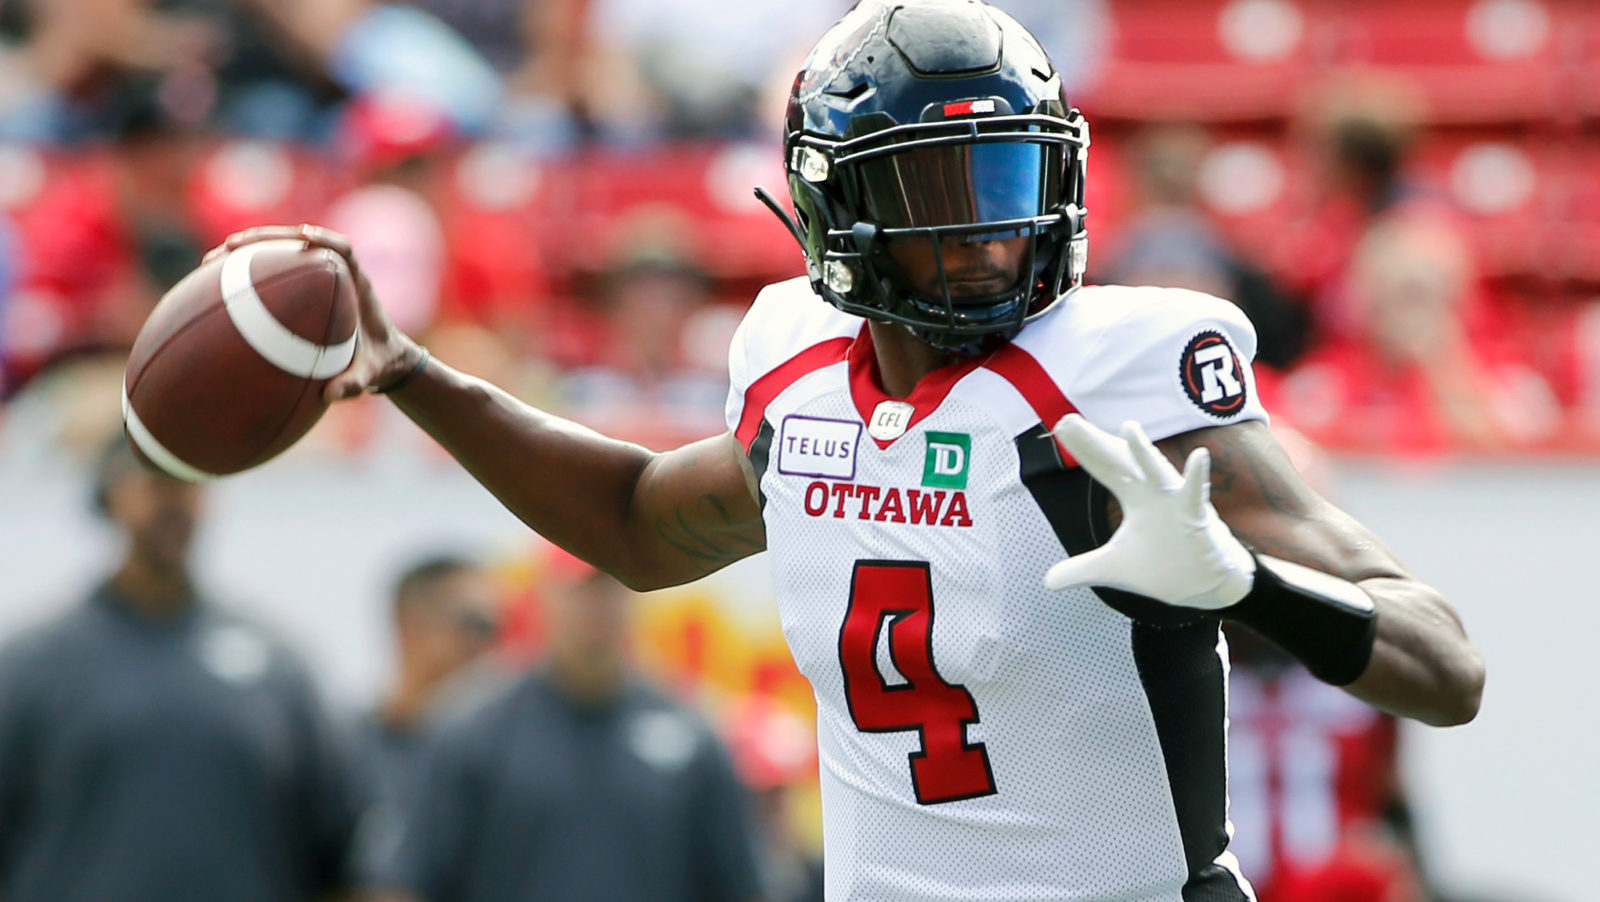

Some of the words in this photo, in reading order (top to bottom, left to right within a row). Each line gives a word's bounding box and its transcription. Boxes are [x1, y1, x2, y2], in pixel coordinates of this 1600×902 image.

[1194, 344, 1242, 403] R
[877, 412, 901, 427] CFL
[787, 436, 850, 458] TELUS
[929, 443, 965, 475] TD
[804, 481, 973, 527] OTTAWA
[838, 559, 998, 805] 4
